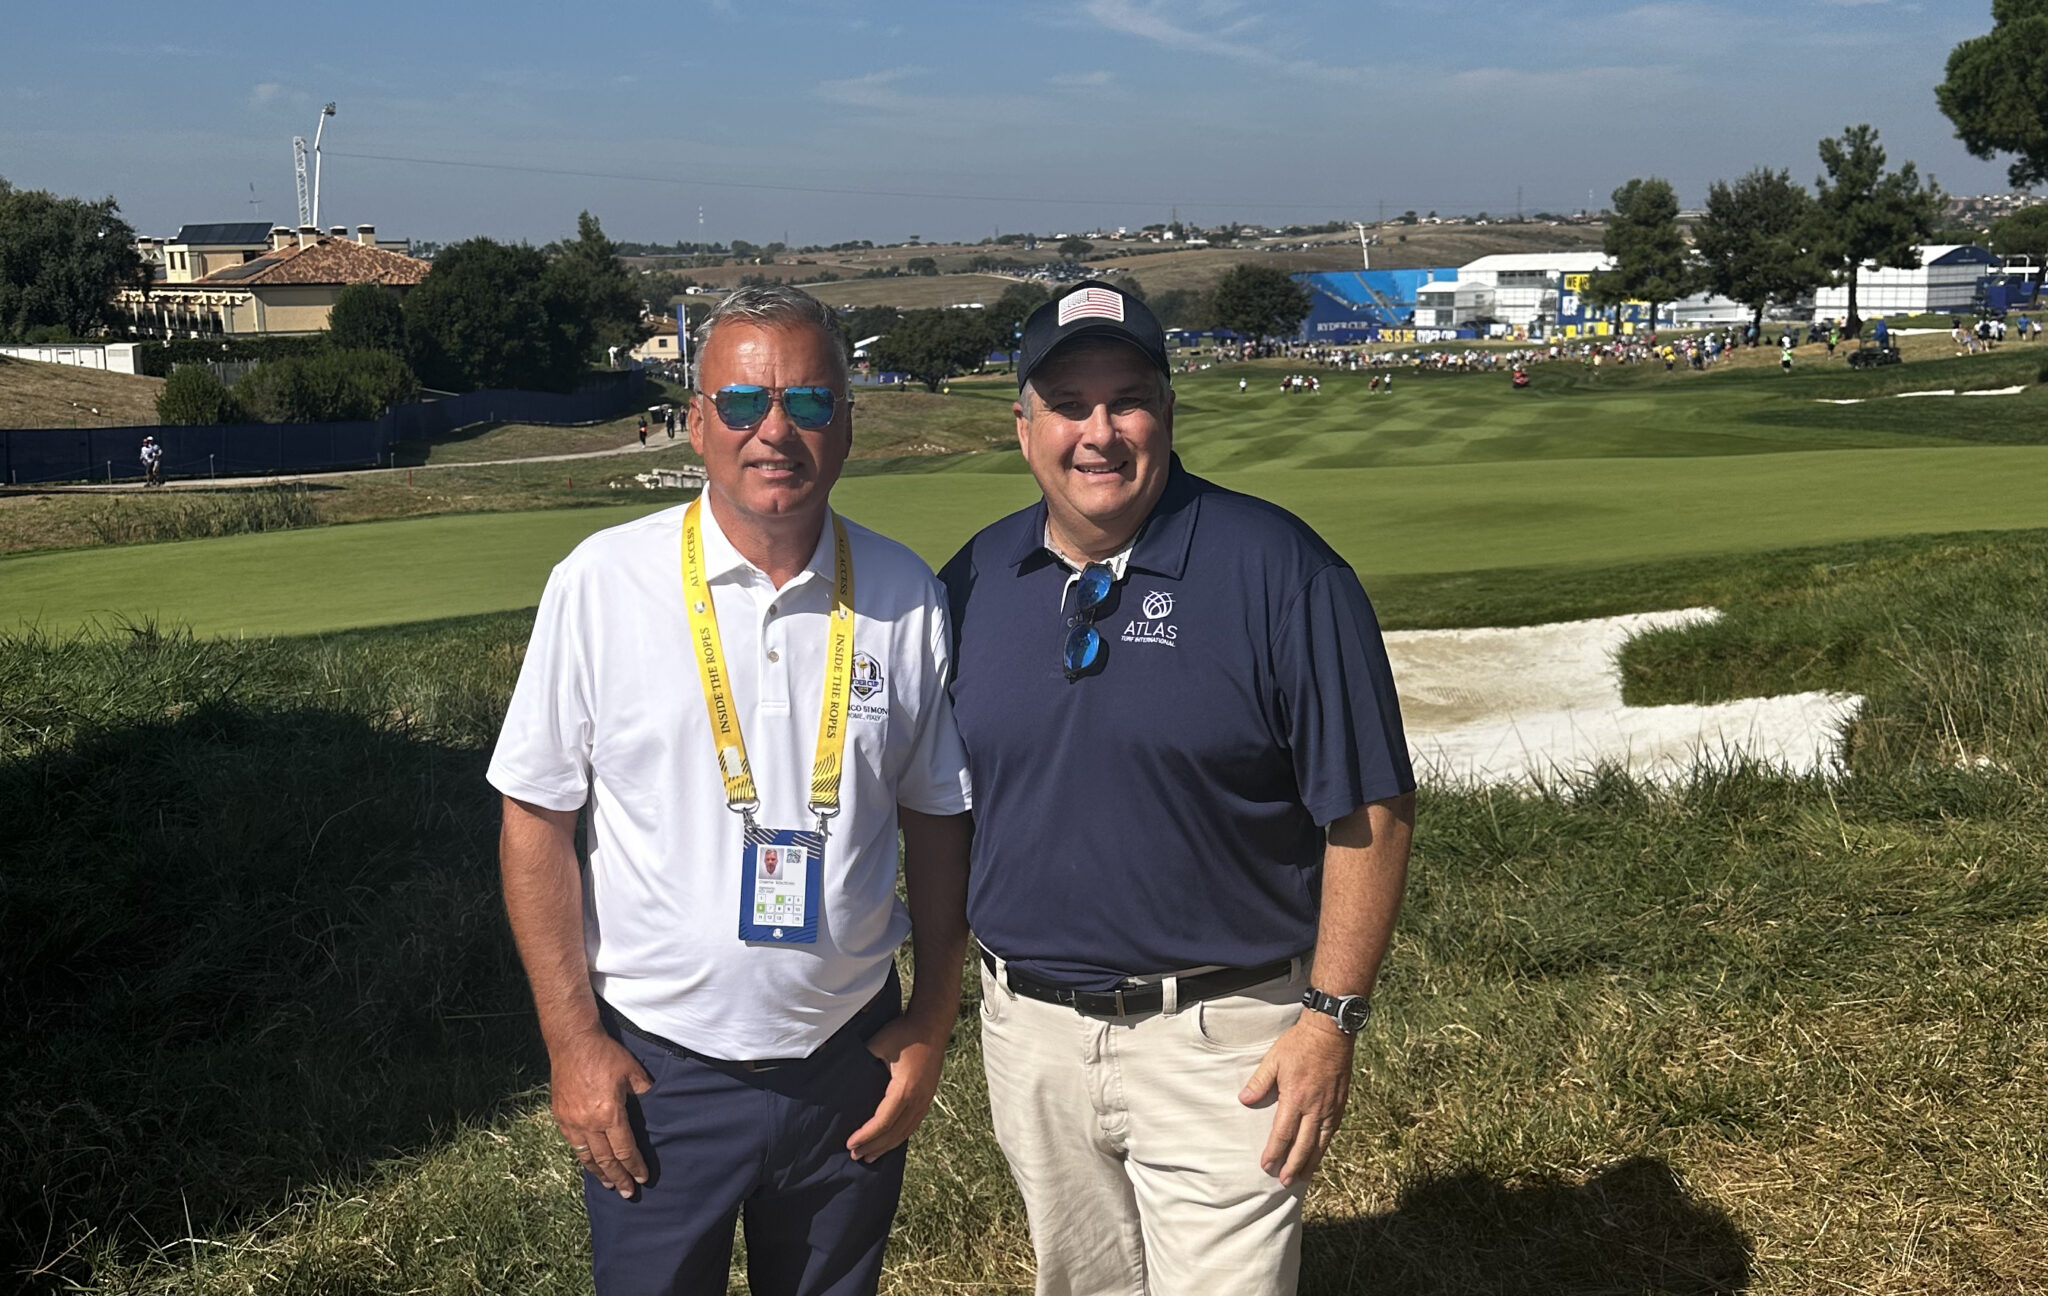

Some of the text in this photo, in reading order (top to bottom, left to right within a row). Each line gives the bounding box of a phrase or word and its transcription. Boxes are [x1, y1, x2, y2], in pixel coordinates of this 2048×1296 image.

[687, 526, 700, 587] ALL ACCESS
[840, 556, 848, 596] ACCESS
[1123, 620, 1178, 639] ATLAS
[700, 627, 731, 734] INSIDE THE ROPES
[827, 633, 845, 738] INSIDE THE ROPES
[863, 705, 888, 715] SIMON
